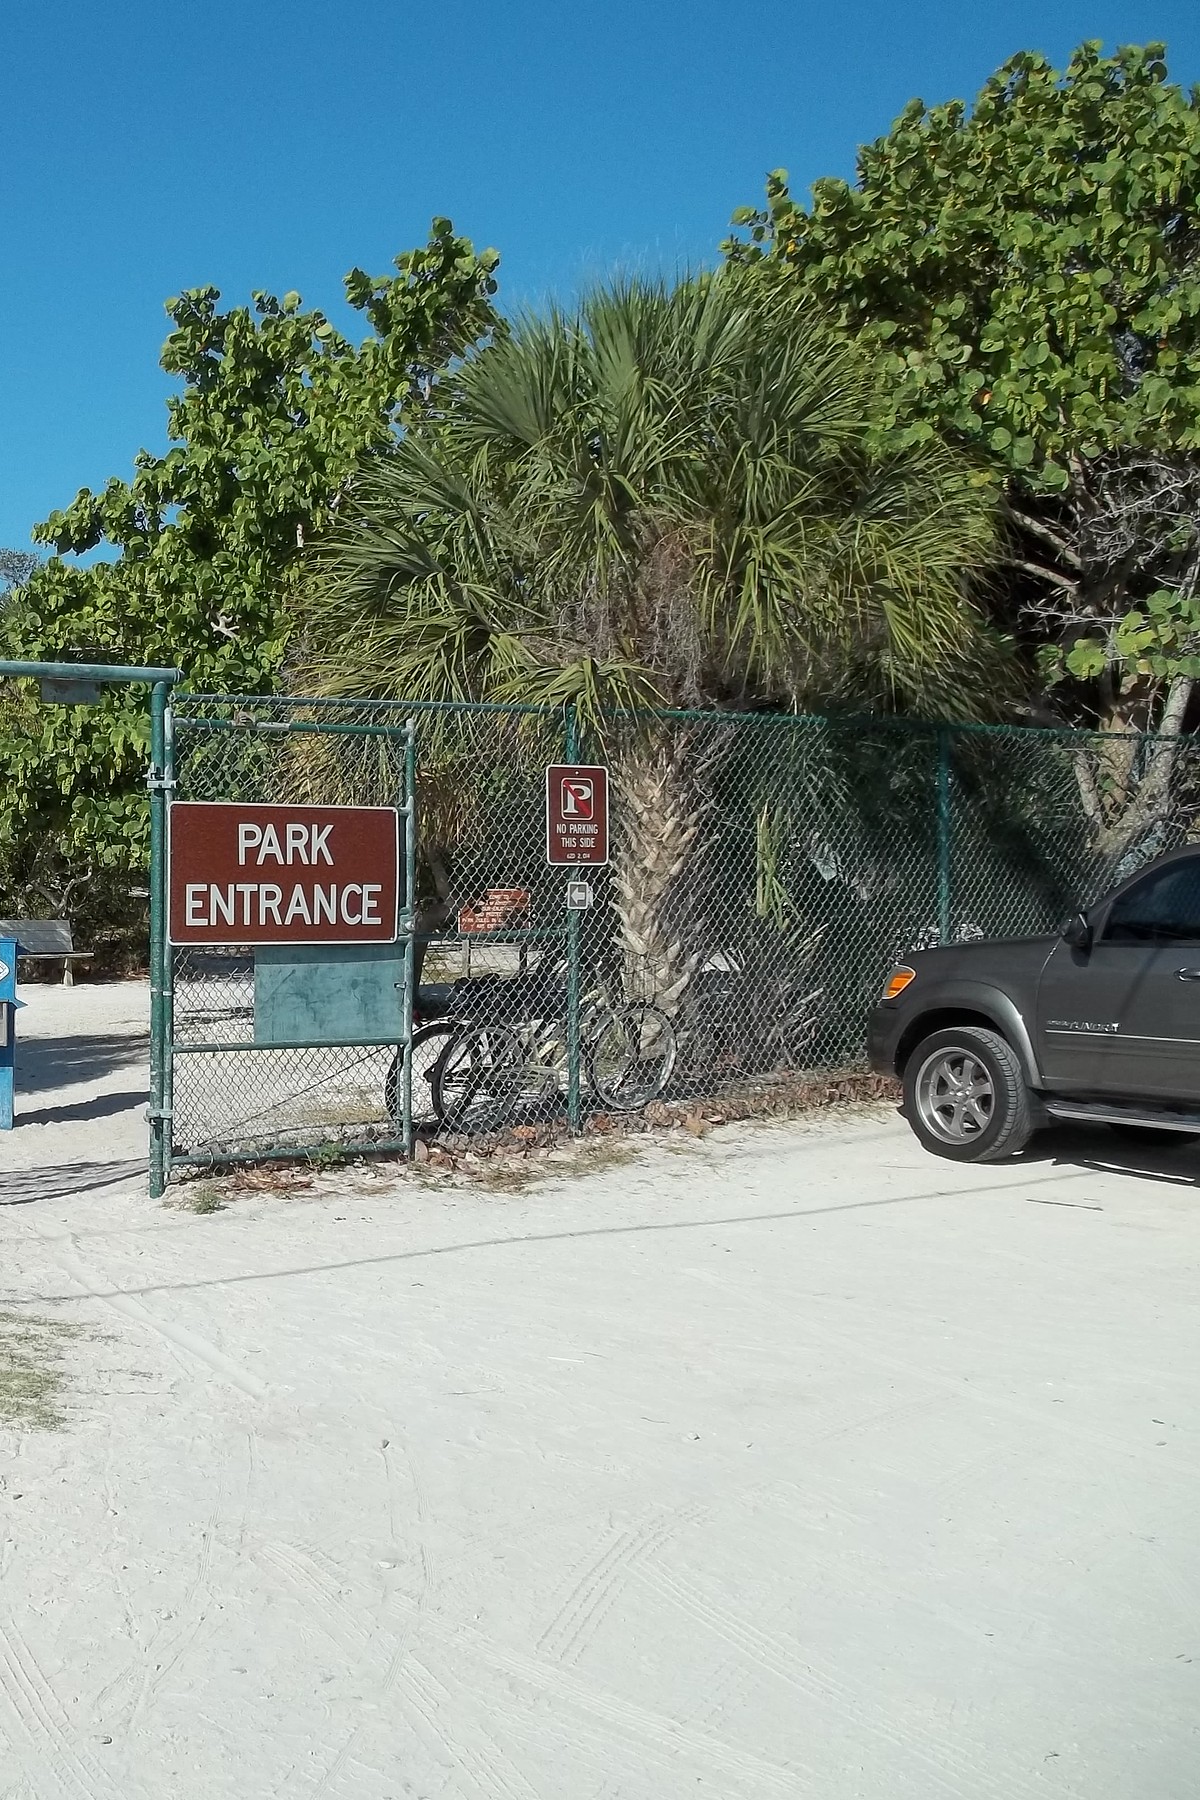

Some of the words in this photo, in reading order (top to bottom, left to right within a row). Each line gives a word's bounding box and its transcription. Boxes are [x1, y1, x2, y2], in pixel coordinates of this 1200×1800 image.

[556, 823, 567, 834] NO
[569, 823, 599, 835] PARKING
[560, 837, 577, 848] THIS
[579, 837, 596, 848] SIDE
[237, 823, 335, 866] PARK
[185, 883, 382, 926] ENTRANCE
